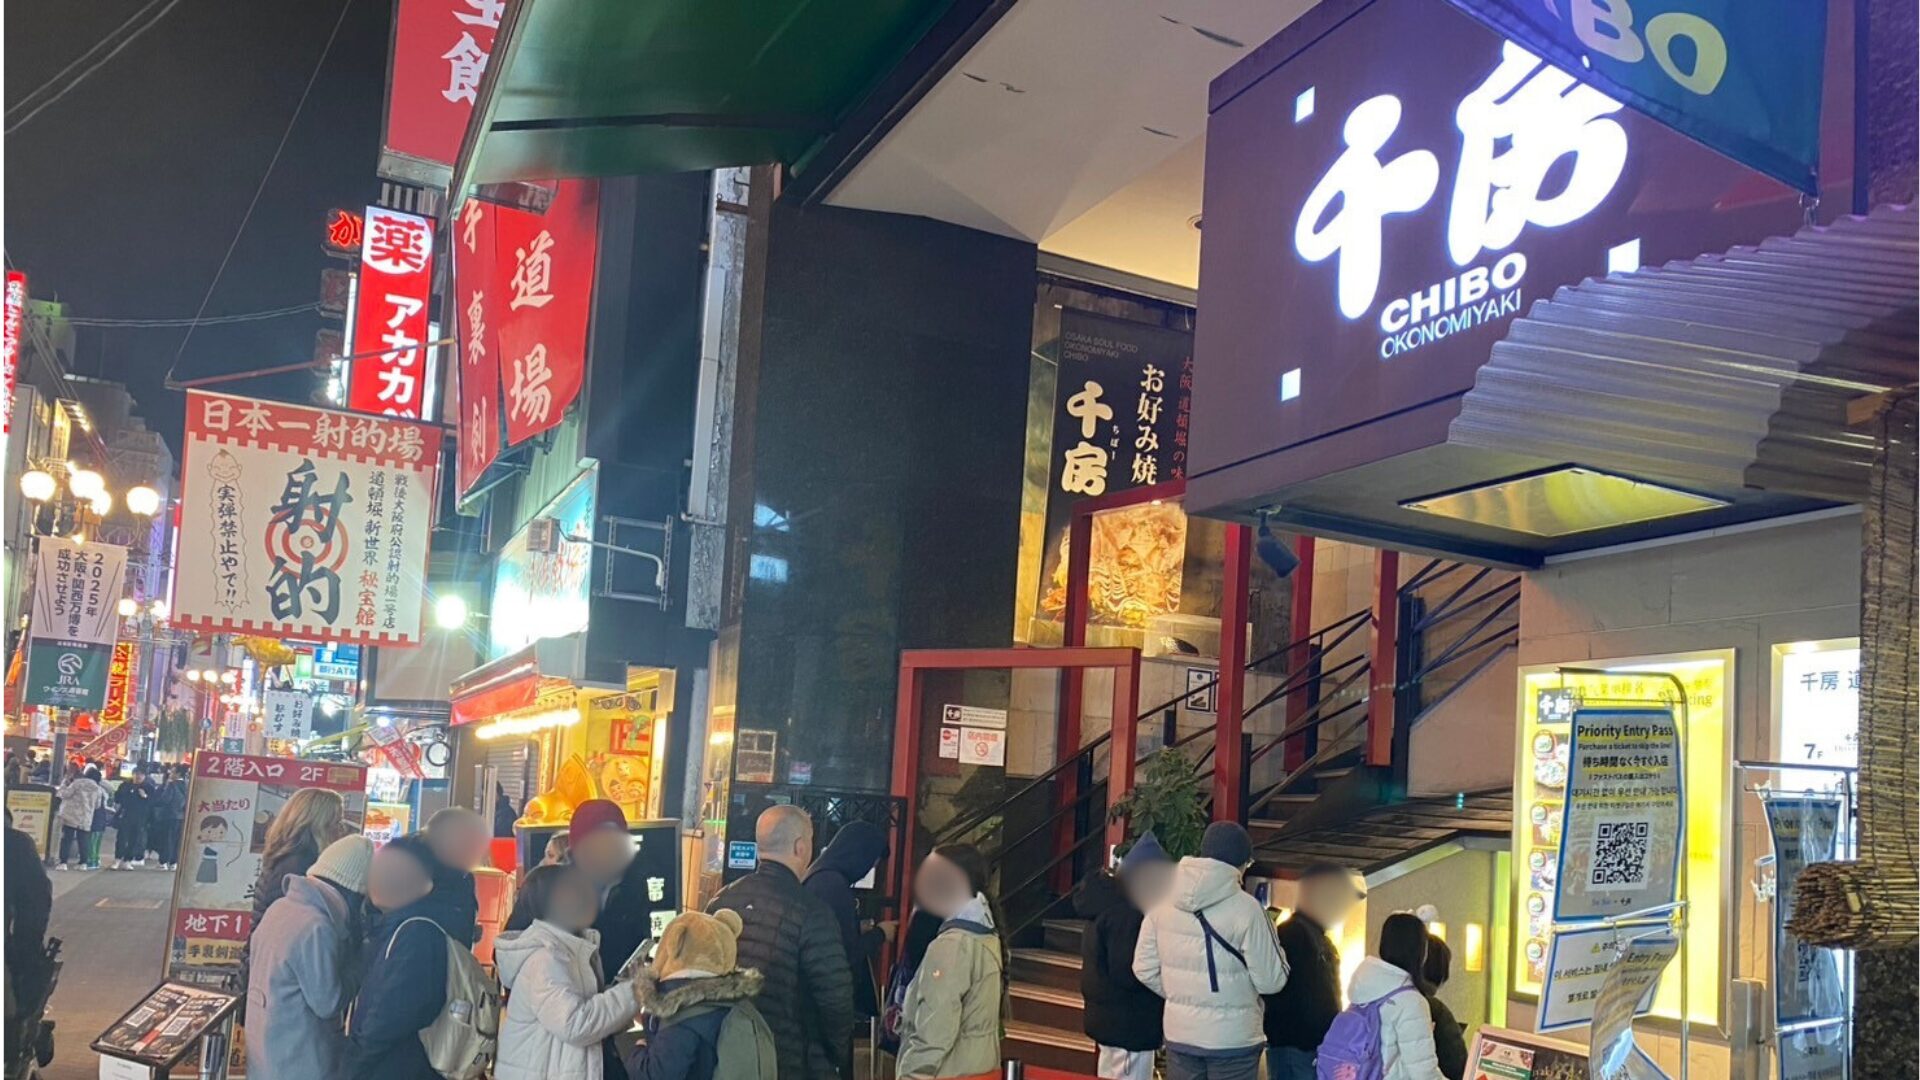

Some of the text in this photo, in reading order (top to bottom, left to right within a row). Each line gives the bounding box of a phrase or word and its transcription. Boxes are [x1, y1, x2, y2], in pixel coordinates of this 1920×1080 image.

[1295, 39, 1628, 320] 千房
[371, 214, 426, 272] 薬
[1379, 252, 1527, 334] CHIBO
[1381, 287, 1522, 360] OKONOMIYAKI
[509, 229, 556, 427] 道場
[203, 400, 426, 462] 日本一射的場
[1061, 380, 1114, 496] 千房
[1131, 363, 1166, 485] お好み焼
[266, 458, 354, 625] 射的
[55, 548, 72, 616] 成功させよう
[85, 552, 105, 618] 2025年
[355, 570, 379, 627] 秘宝館
[56, 675, 80, 686] JRA
[1800, 670, 1839, 692] 千房
[1577, 724, 1673, 739] Priority Entry Pass
[1583, 755, 1669, 768] 待ち時間なく今すぐ入店
[207, 756, 285, 778] 2階入口
[301, 766, 324, 782] 2F
[197, 798, 250, 813] 大当たり
[185, 913, 252, 934] 地下1
